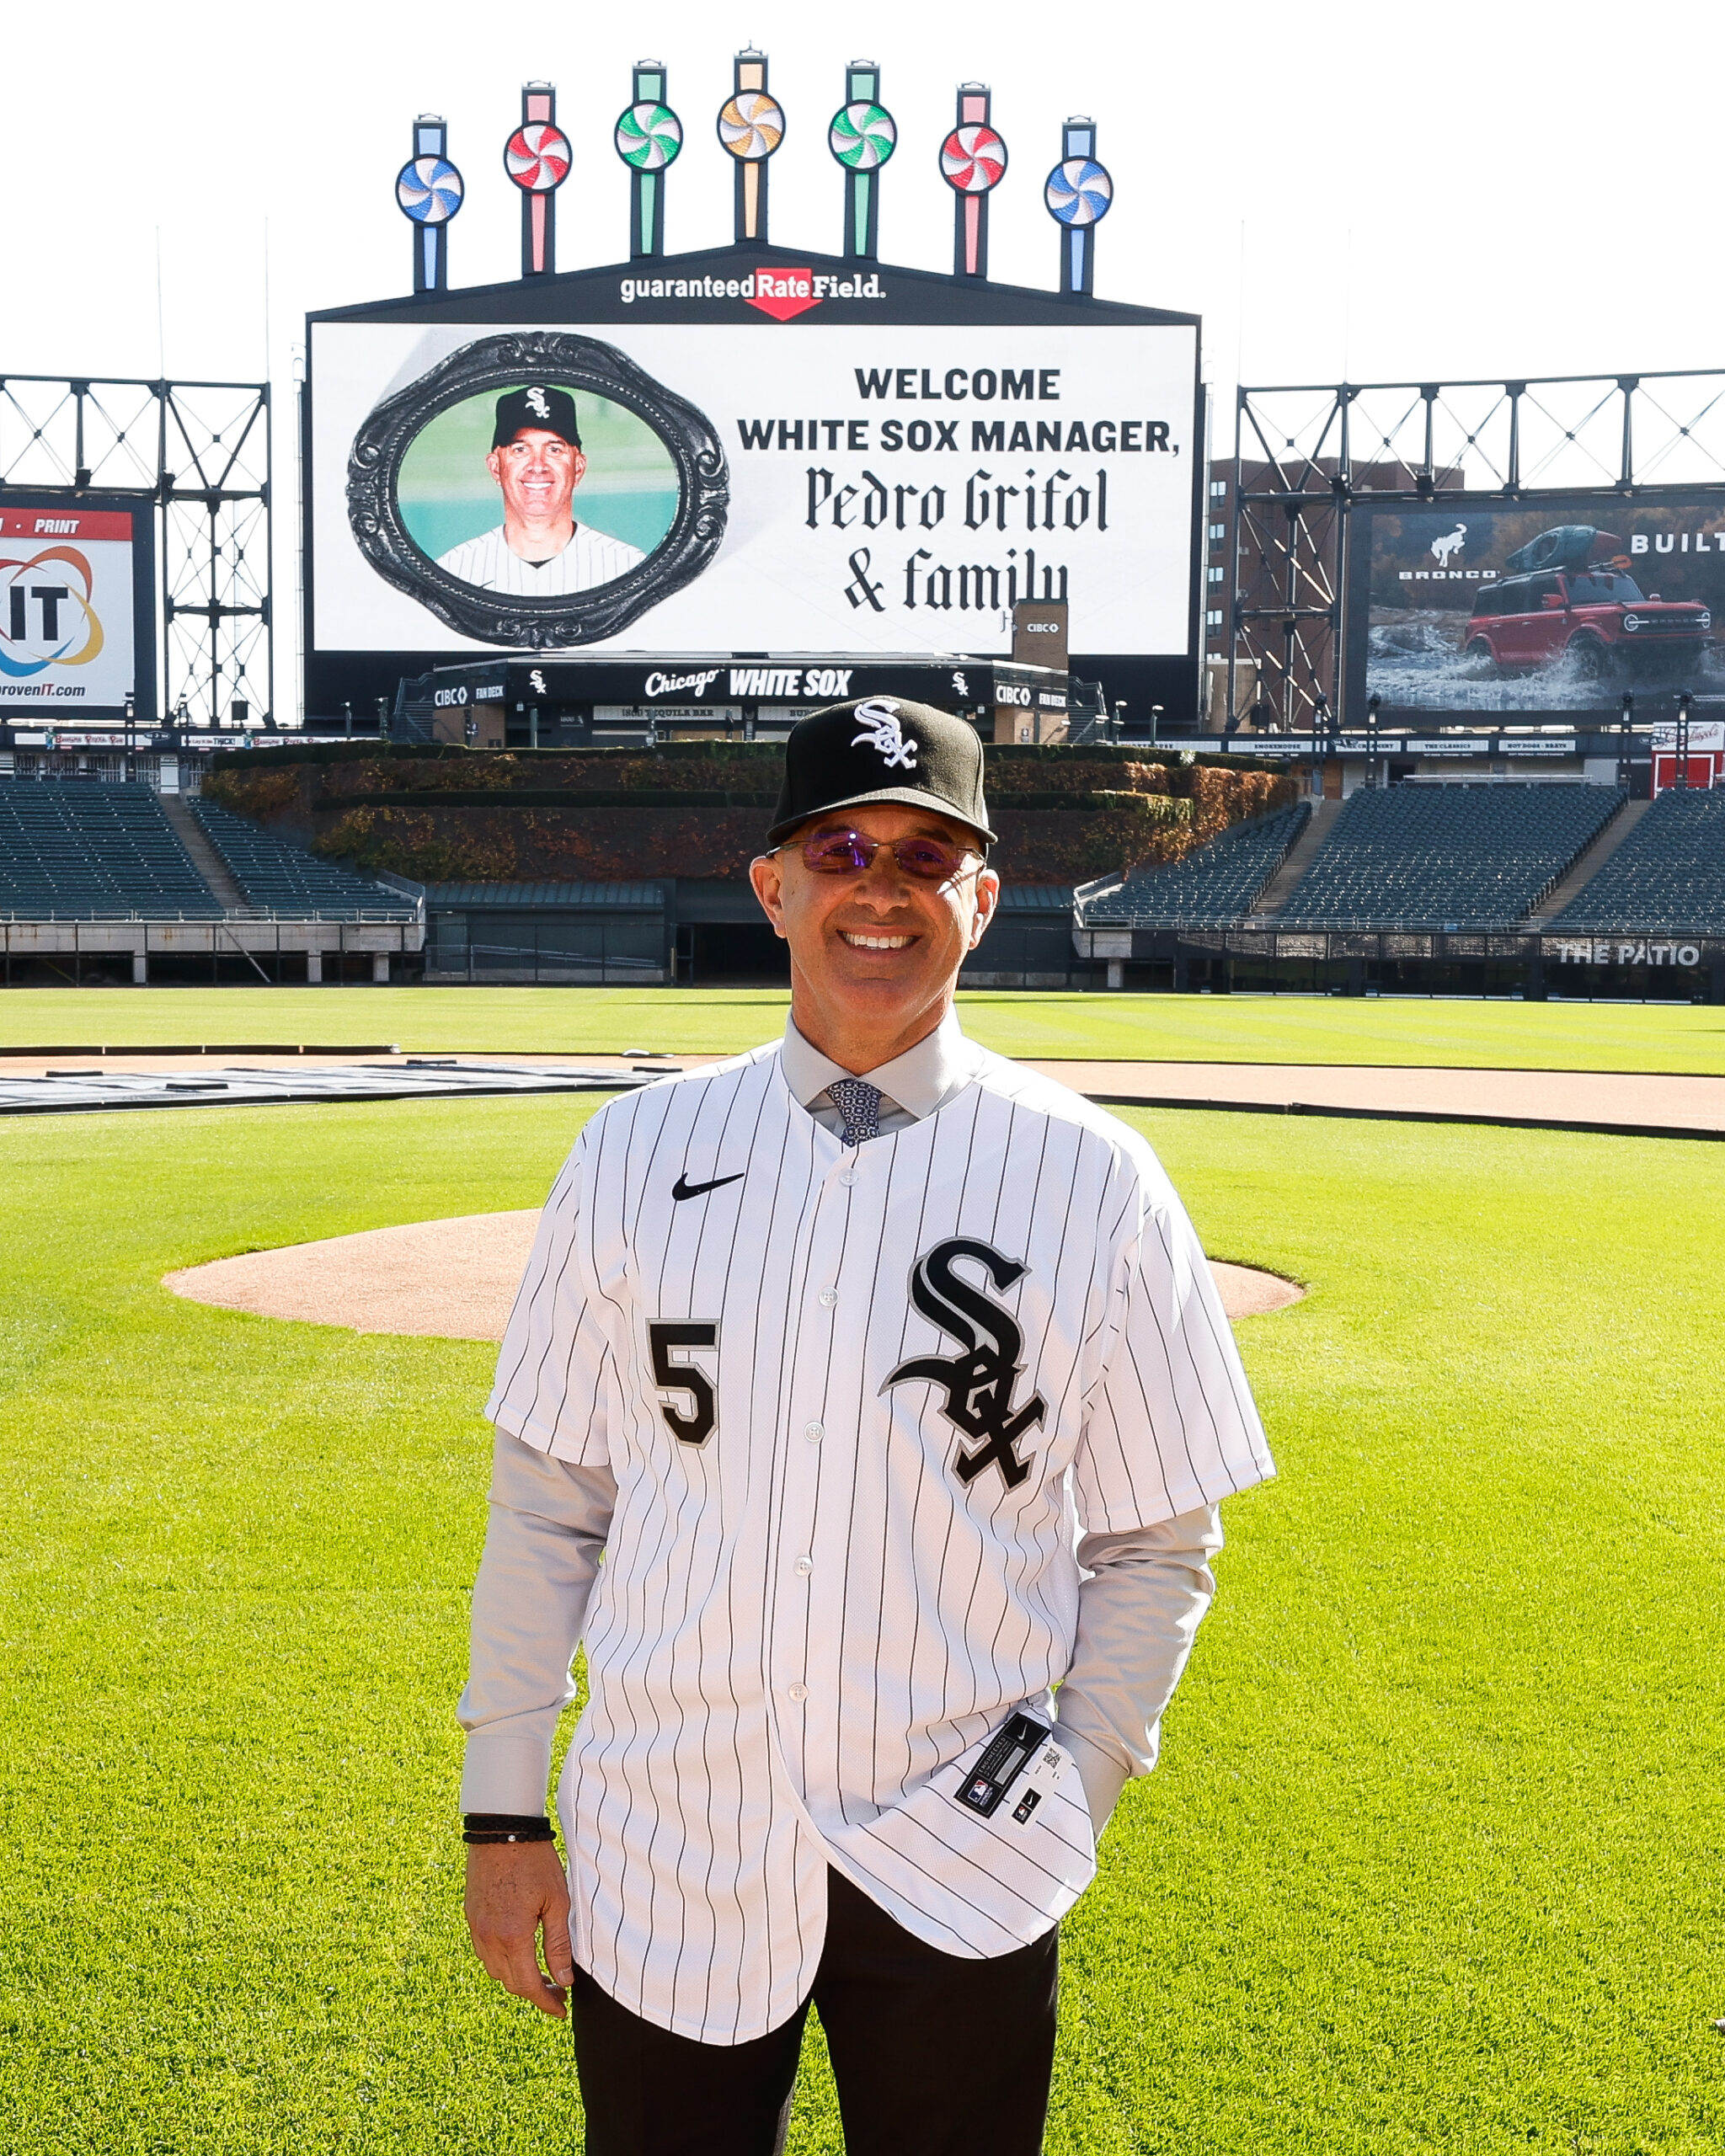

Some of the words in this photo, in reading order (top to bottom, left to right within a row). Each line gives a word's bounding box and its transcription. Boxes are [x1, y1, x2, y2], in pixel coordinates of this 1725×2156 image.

[854, 368, 1060, 401] WELCOME
[737, 419, 869, 451] WHITE
[880, 419, 959, 452] SOX
[971, 420, 1179, 458] MANAGER,
[804, 467, 947, 531] Pedro
[963, 467, 1109, 532] Grifol
[34, 518, 80, 534] PRINT
[1631, 531, 1725, 554] BUILT
[843, 546, 887, 613] &
[1398, 569, 1498, 580] BRONCO
[9, 585, 69, 641] IT
[1027, 623, 1049, 632] CIBC
[0, 683, 86, 697] rovenIT.com
[644, 669, 721, 697] Chicago
[729, 669, 803, 696] WHITE
[803, 669, 853, 697] SOX
[996, 684, 1021, 706] CIBC
[435, 687, 458, 707] CIBC
[475, 686, 488, 700] FAN
[488, 685, 504, 699] DECK
[693, 708, 714, 717] BAR
[1556, 942, 1610, 964] THE
[1618, 944, 1700, 966] PATIO
[645, 1317, 721, 1450] 5
[978, 1737, 1007, 1774] ENGINEERED
